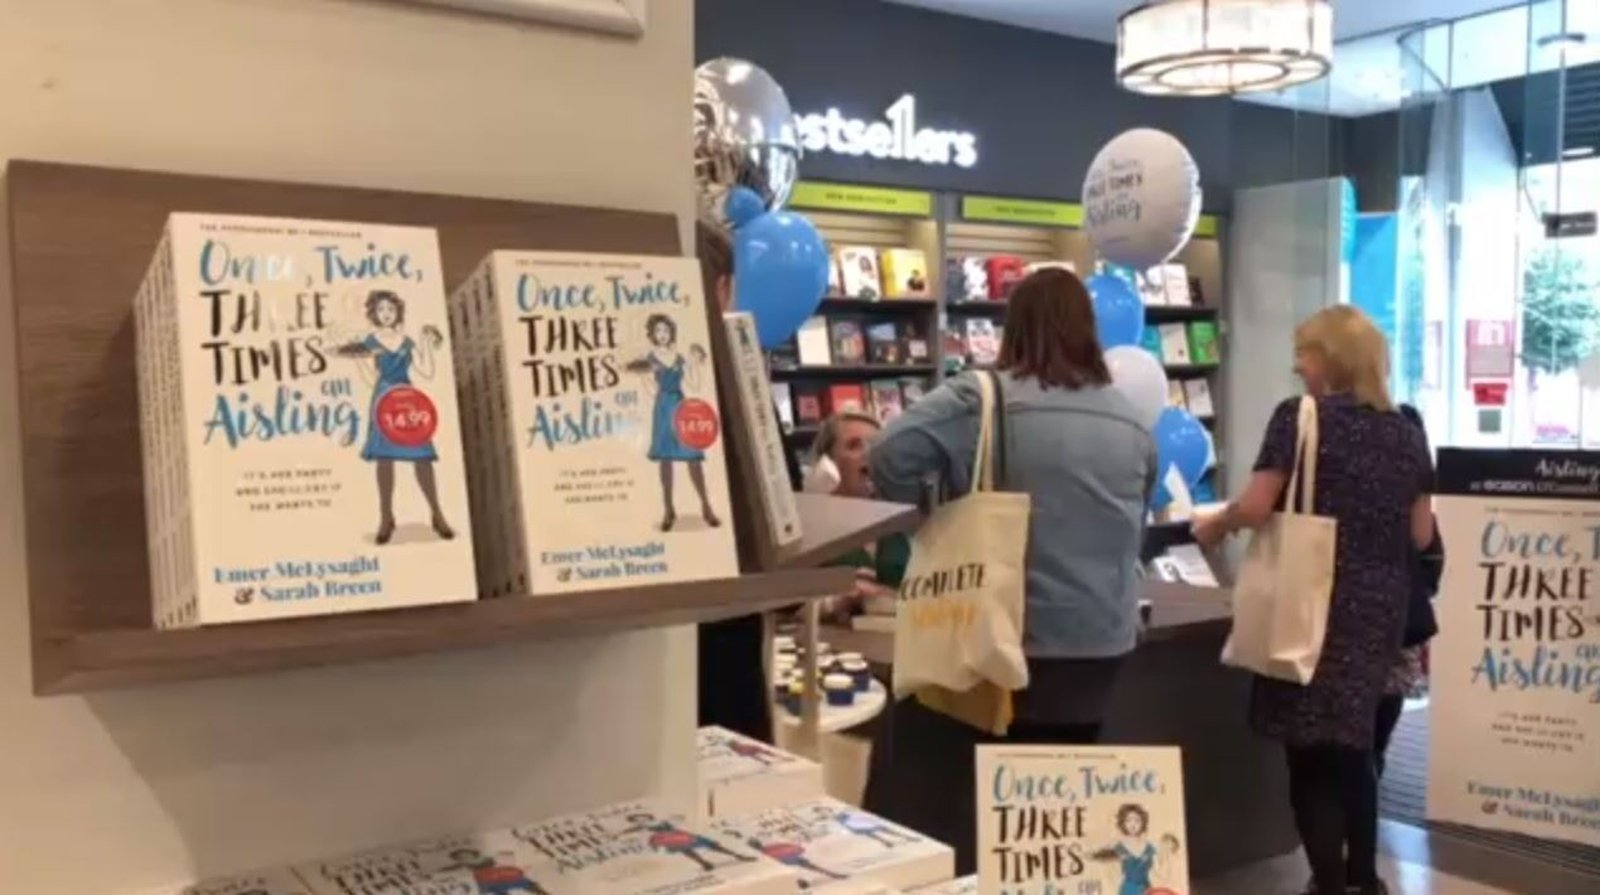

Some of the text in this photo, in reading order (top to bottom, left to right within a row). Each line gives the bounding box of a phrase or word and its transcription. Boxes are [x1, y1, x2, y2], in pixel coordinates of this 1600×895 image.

[797, 93, 978, 168] stsellers
[200, 239, 423, 287] On, Twice,
[517, 272, 691, 312] Once, Twice,
[200, 290, 330, 337] THEE
[518, 315, 620, 356] THREE
[201, 337, 328, 386] TIMES
[522, 355, 621, 398] TIMES
[321, 378, 353, 398] an
[203, 386, 360, 450] Aisling
[1481, 519, 1581, 563] Once,
[260, 579, 320, 602] Sarah
[326, 579, 382, 598] Breen
[1478, 562, 1593, 601] THREE
[1475, 604, 1584, 641] TIMES
[992, 762, 1166, 803] Once, Twice,
[992, 804, 1087, 844] THREE
[992, 843, 1085, 883] TIMES
